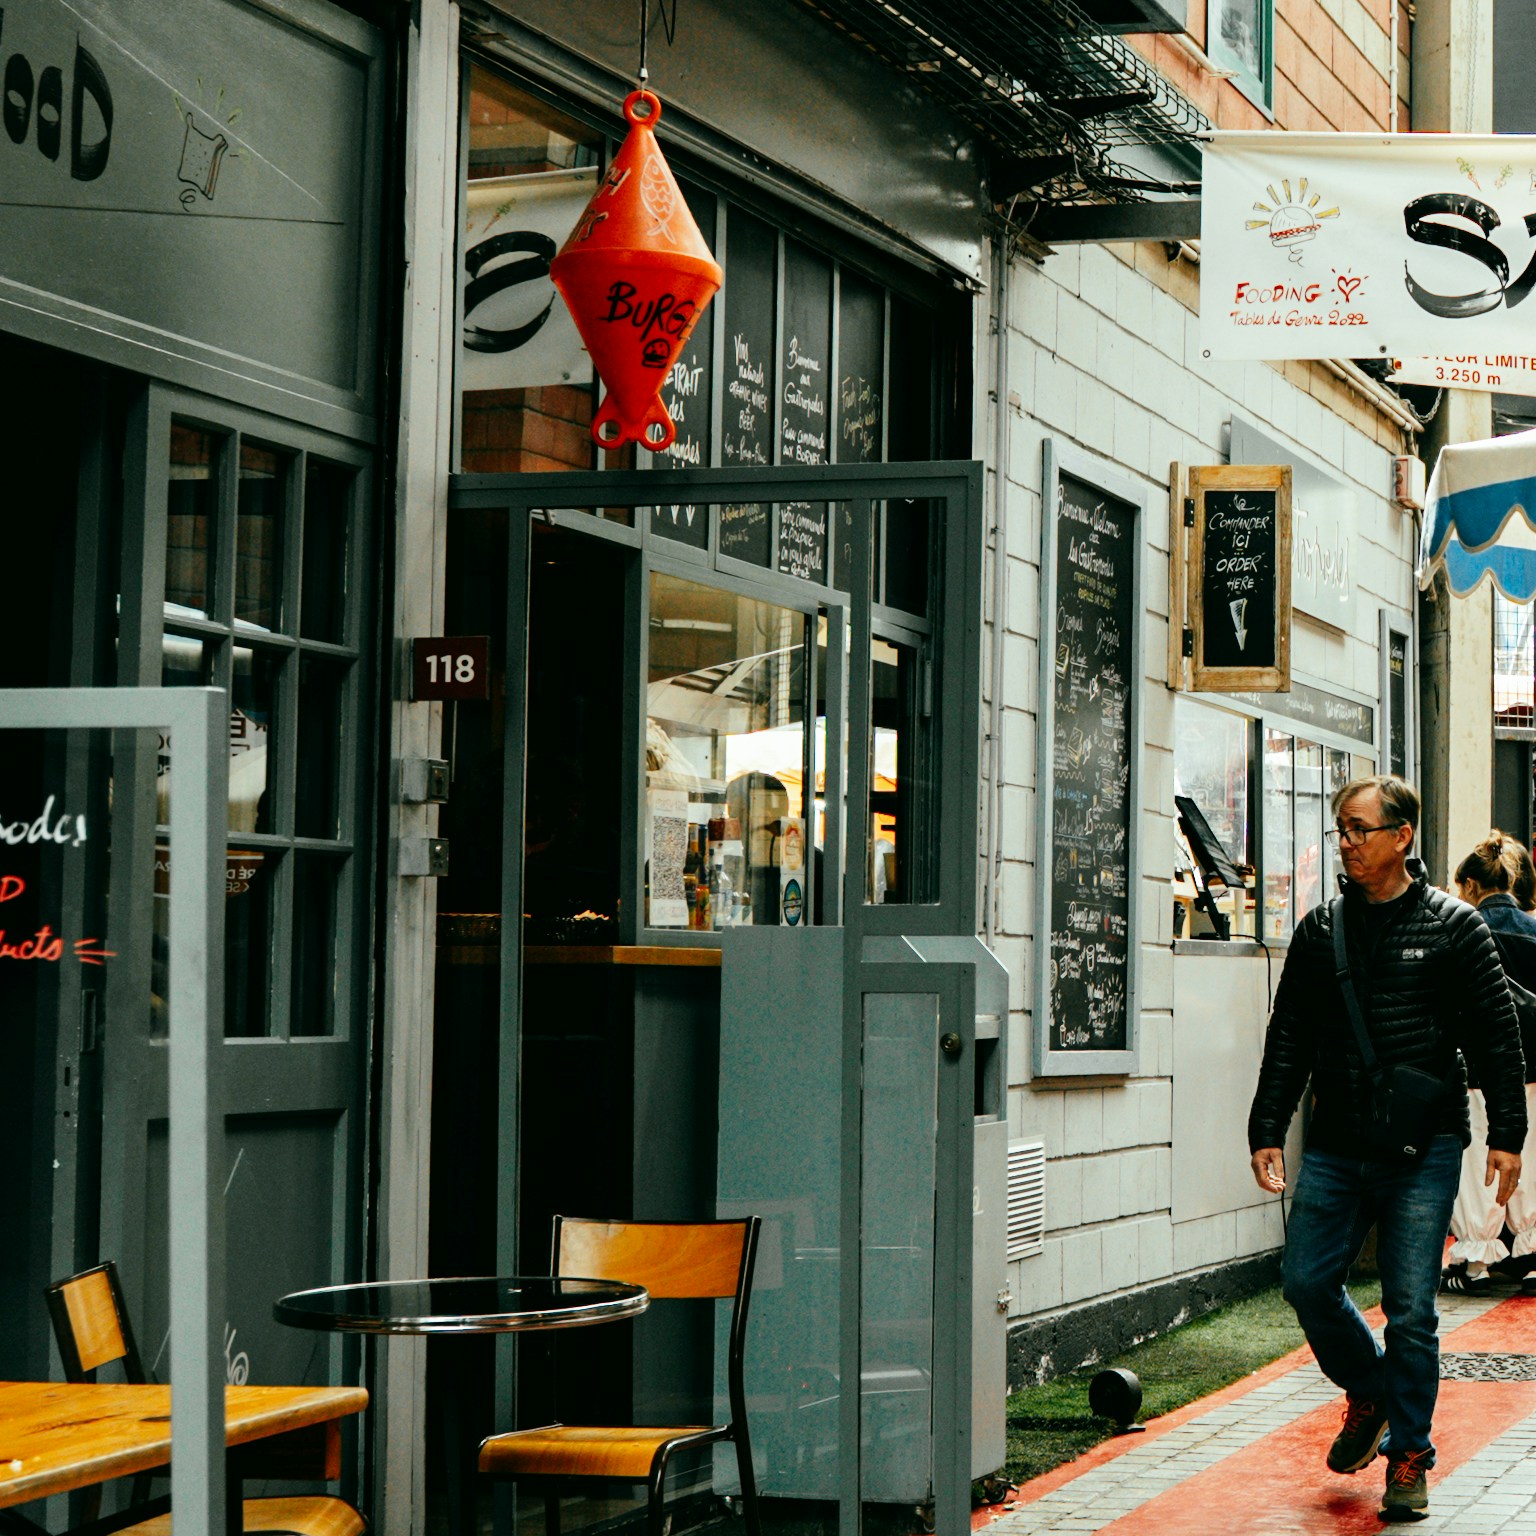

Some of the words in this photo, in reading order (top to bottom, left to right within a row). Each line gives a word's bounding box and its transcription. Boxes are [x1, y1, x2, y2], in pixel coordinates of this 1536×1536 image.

[1267, 310, 1281, 326] de
[1328, 310, 1369, 326] 2022
[1436, 367, 1480, 384] 3.250
[1487, 374, 1501, 385] m
[669, 394, 685, 423] des
[1209, 512, 1270, 534] COMMANDER
[1216, 555, 1262, 574] ORDER
[1227, 575, 1255, 591] HERE
[425, 654, 475, 683] 118
